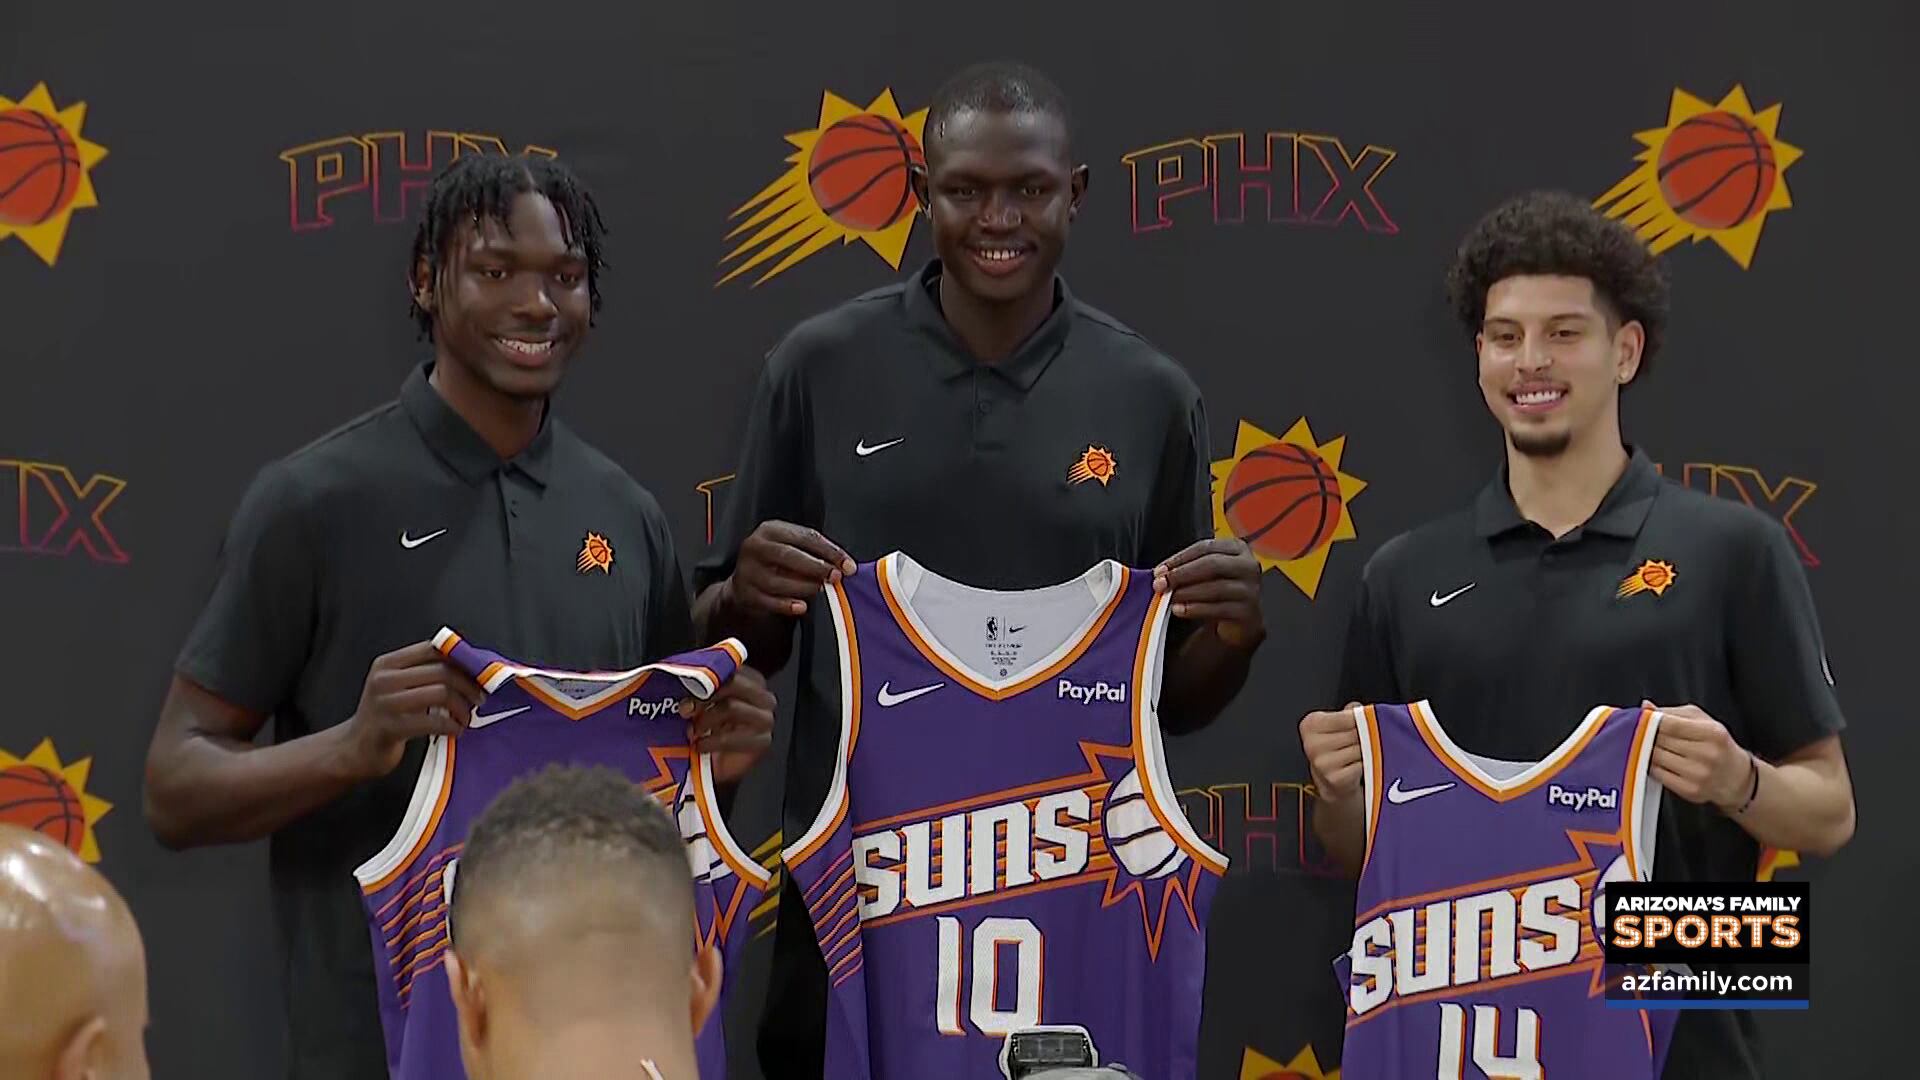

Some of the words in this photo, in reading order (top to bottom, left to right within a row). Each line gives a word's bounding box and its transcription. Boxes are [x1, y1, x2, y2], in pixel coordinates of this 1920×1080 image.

[280, 130, 558, 232] PH
[1121, 132, 1400, 233] PHX
[628, 697, 680, 720] PayPa
[1057, 680, 1126, 705] PayPal
[1548, 786, 1617, 812] PayPal
[852, 790, 1092, 922] SUNS
[935, 916, 1044, 1038] 10
[1346, 876, 1581, 1016] SUNS
[1437, 1002, 1545, 1080] 14
